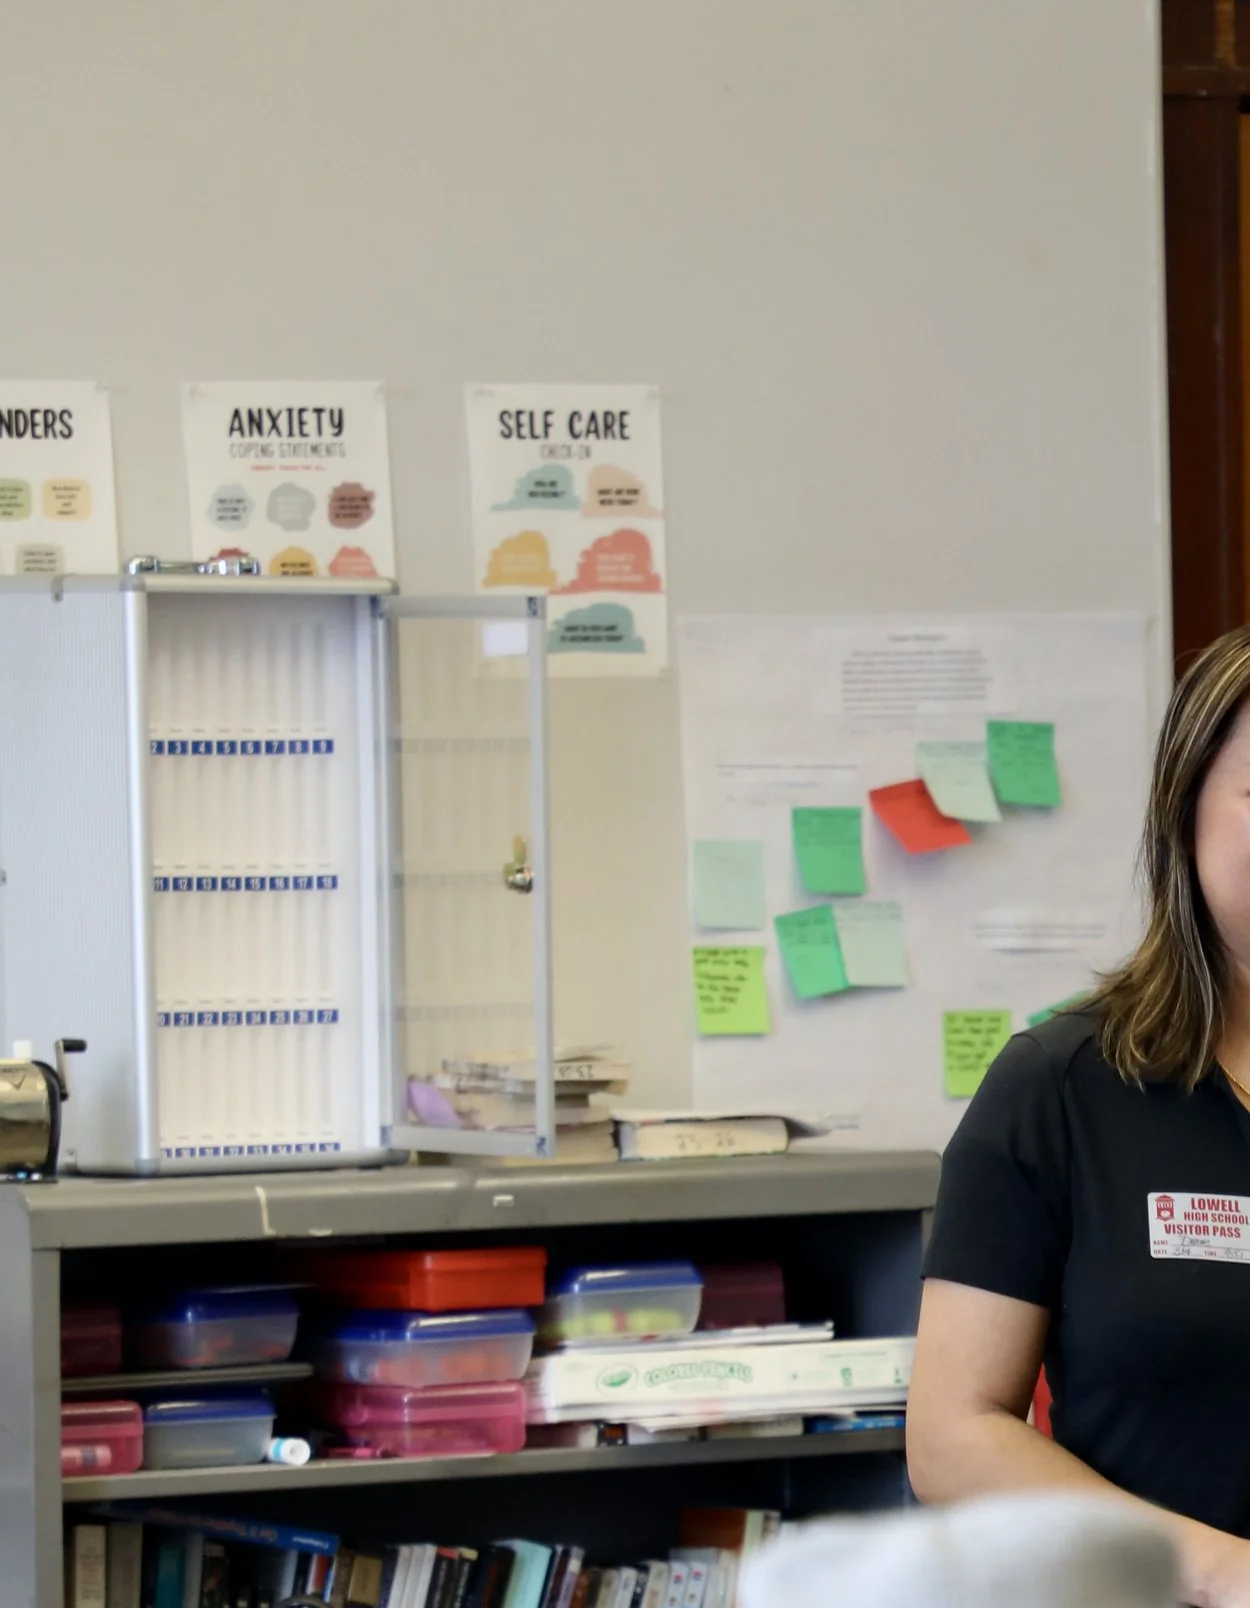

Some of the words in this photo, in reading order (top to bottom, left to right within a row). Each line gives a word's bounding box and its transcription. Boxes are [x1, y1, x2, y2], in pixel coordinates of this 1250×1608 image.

[228, 407, 345, 438] ANXIETY
[498, 409, 555, 440] SELF
[568, 410, 631, 440] CARE
[230, 442, 275, 459] COPING
[1191, 1198, 1241, 1213] LOWELL
[1184, 1212, 1209, 1223] HIGH
[1211, 1213, 1250, 1225] SCHOOL
[1164, 1224, 1210, 1236] VISITOR
[1213, 1226, 1241, 1238] PASS
